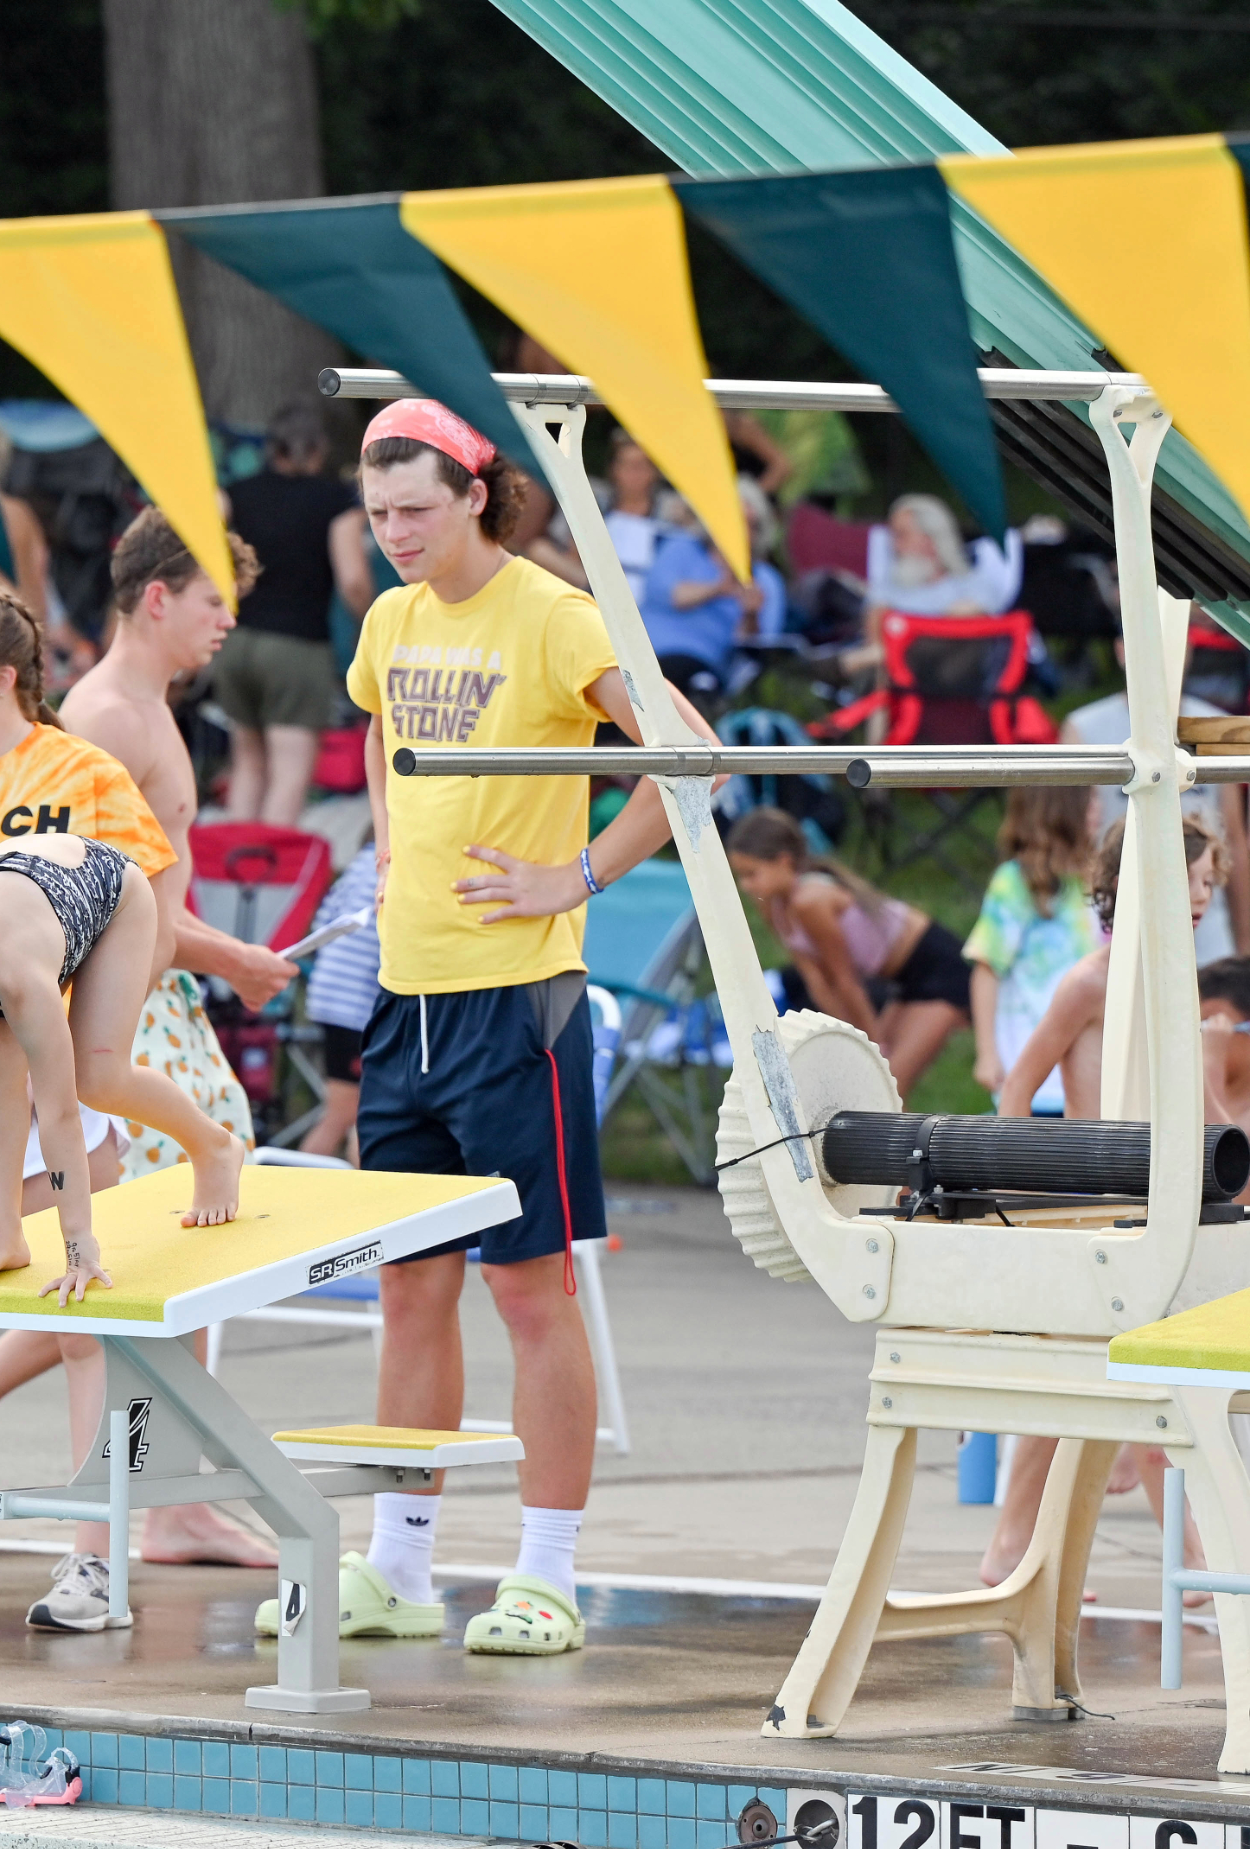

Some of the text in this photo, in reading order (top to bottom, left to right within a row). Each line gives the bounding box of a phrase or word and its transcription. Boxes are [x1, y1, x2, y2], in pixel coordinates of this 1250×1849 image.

[392, 644, 501, 670] PAPA WAS A
[391, 703, 481, 743] STONE
[102, 1397, 152, 1472] 4
